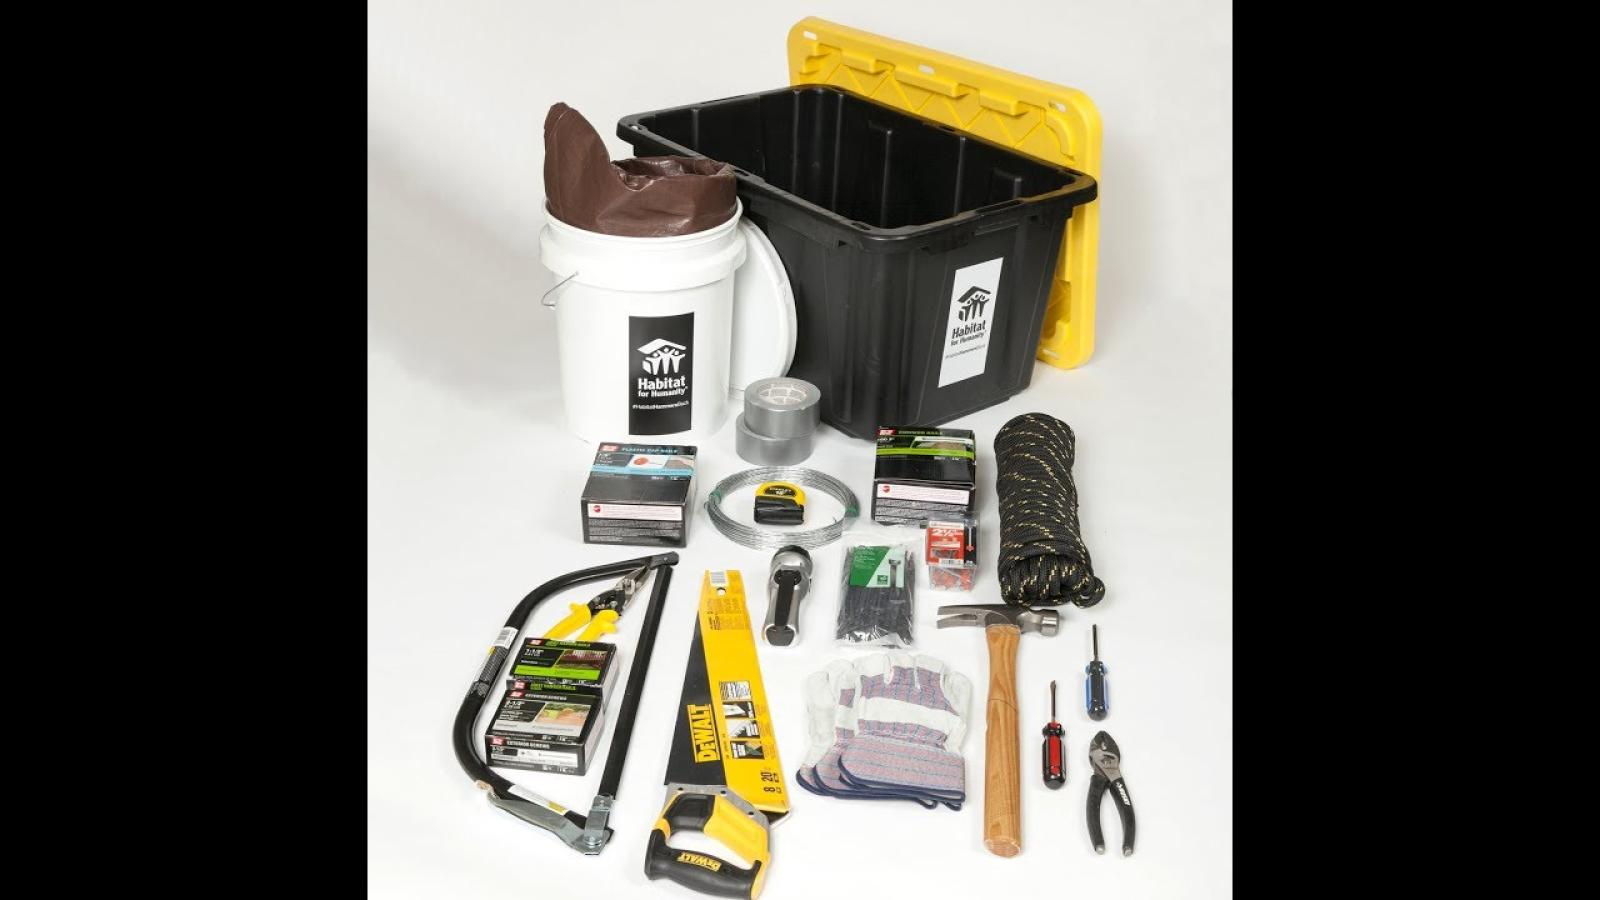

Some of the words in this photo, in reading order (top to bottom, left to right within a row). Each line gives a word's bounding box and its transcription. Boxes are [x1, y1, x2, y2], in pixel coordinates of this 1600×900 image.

[952, 320, 986, 339] Habitat
[638, 376, 686, 390] Habitat
[651, 388, 686, 397] Humanity
[691, 704, 719, 762] DEWALT
[761, 772, 773, 782] 20
